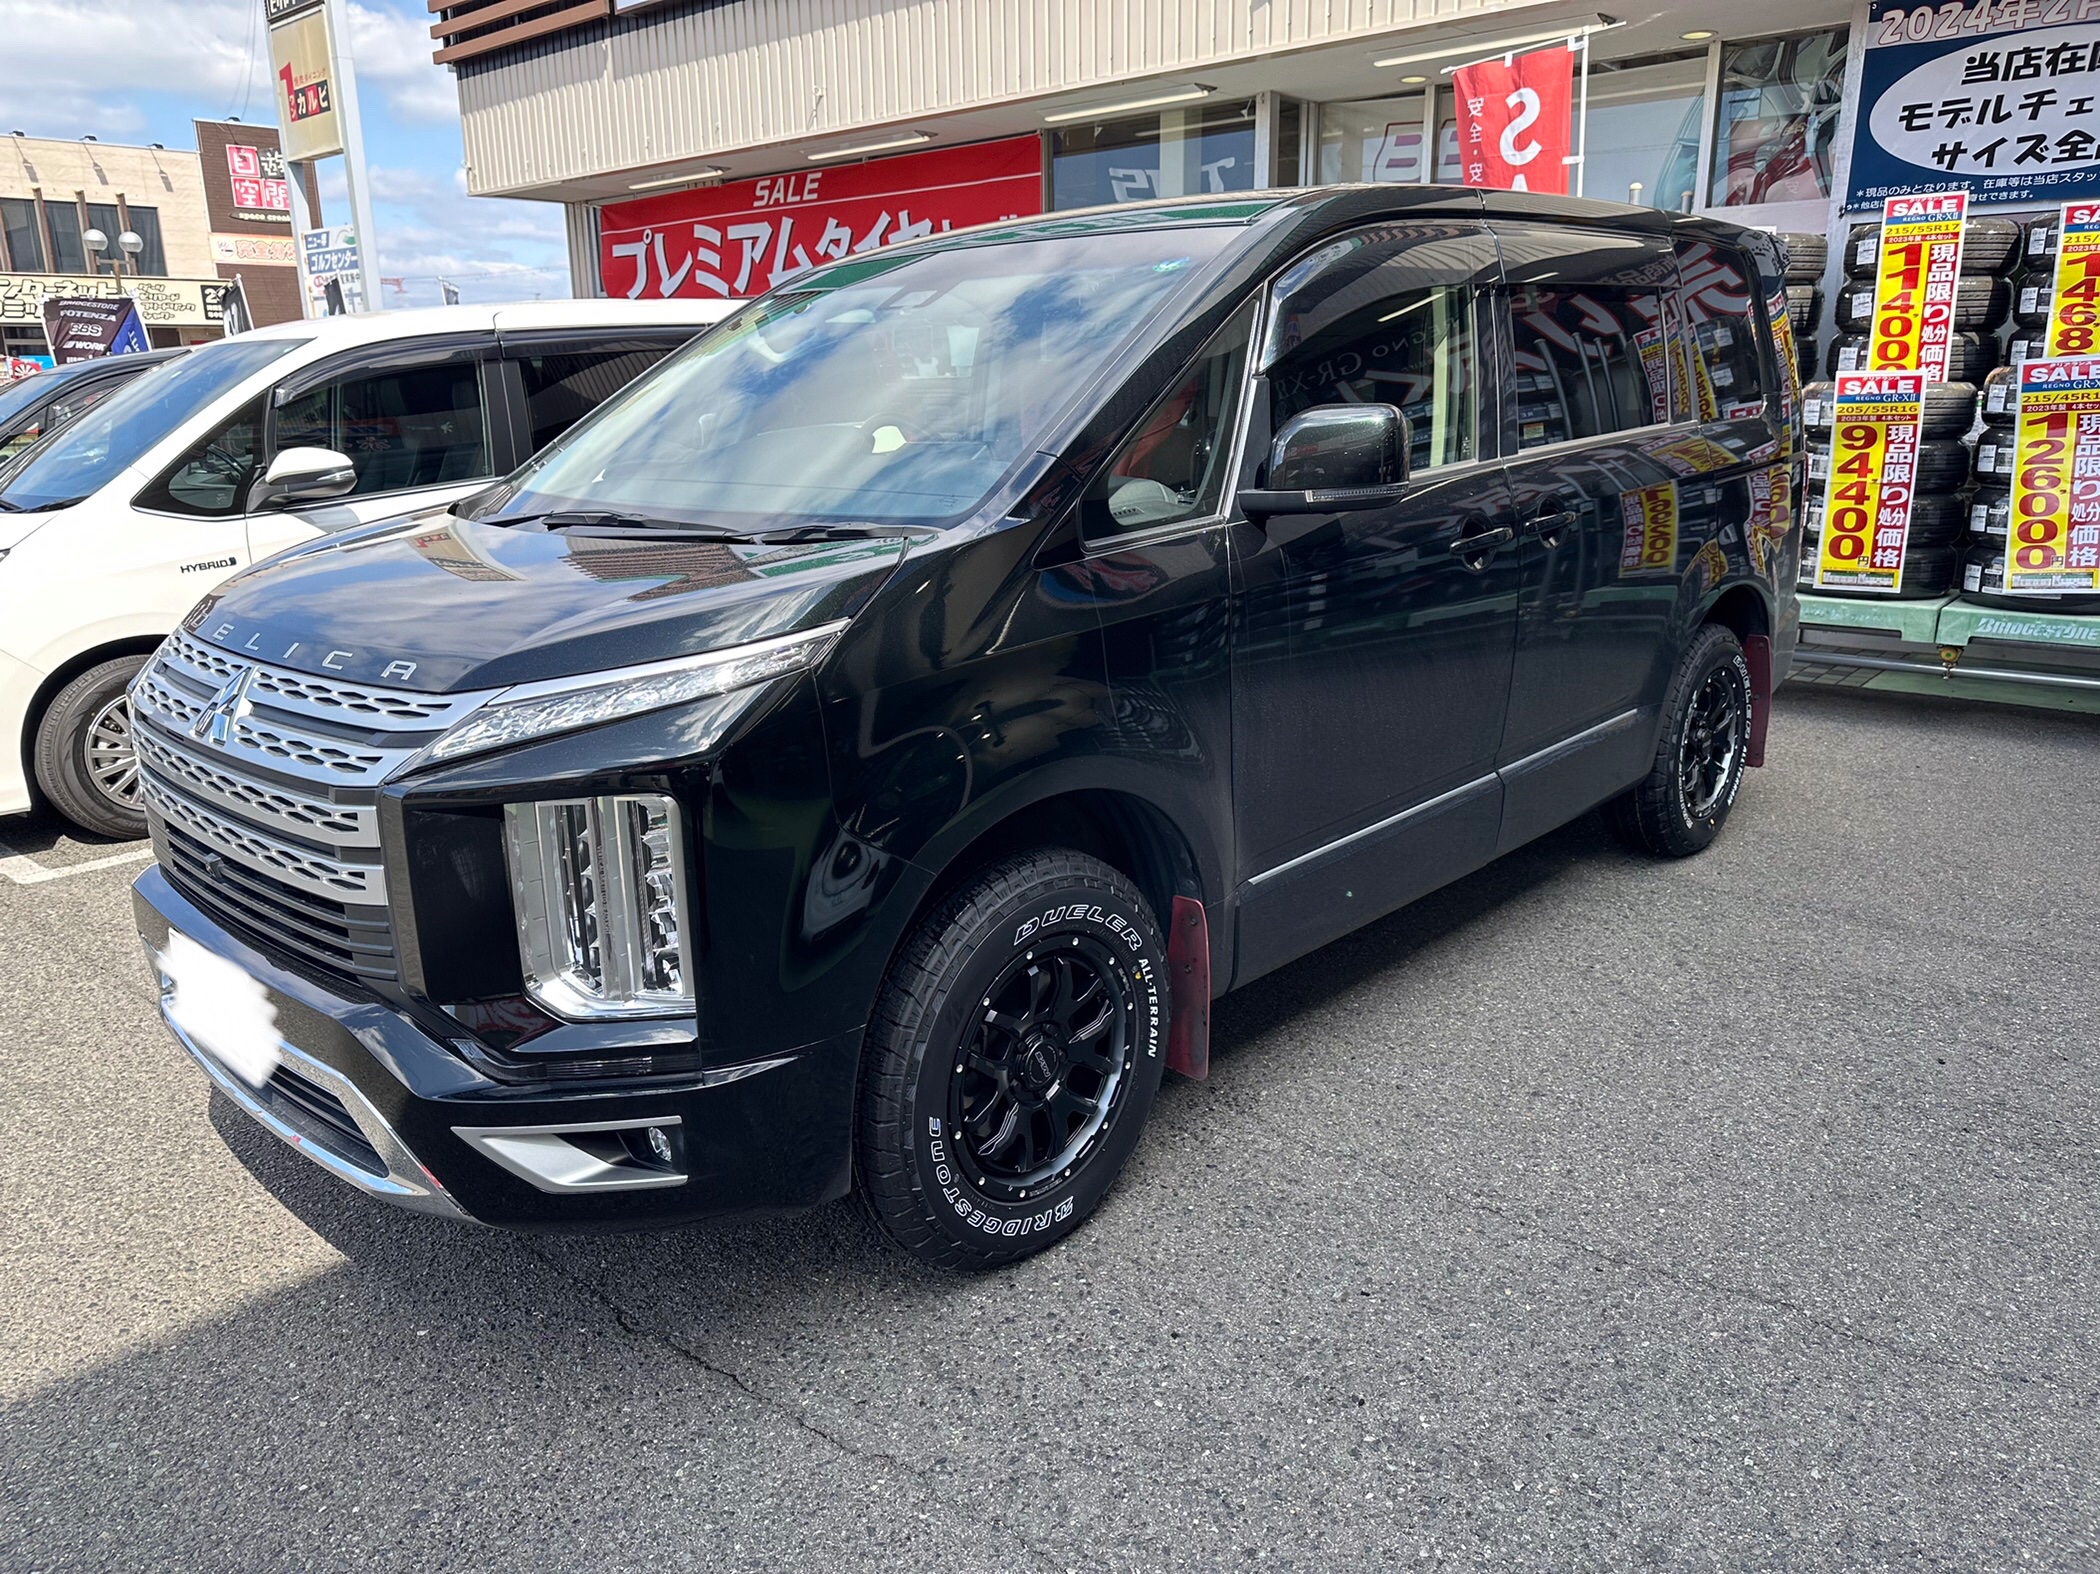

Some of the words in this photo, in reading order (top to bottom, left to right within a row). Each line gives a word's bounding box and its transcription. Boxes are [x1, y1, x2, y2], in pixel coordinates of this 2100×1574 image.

[297, 84, 329, 115] カルビ
[1899, 88, 2095, 132] モデルチェ
[1931, 129, 2100, 171] サイズ全
[752, 172, 822, 208] SALE
[1892, 199, 1958, 216] SALE
[1886, 223, 1960, 235] 215/55R17
[311, 250, 358, 272] ゴルフセンター
[58, 301, 120, 310] BRIDGESTONE
[60, 310, 117, 321] POTENZA
[1917, 243, 1957, 383] 現品限り処分価格
[69, 322, 103, 337] BBS
[74, 341, 107, 351] WORK
[2029, 364, 2100, 383] SALE
[1844, 379, 1915, 395] SALE
[1837, 406, 1918, 415] 205/55R16
[1873, 425, 1915, 568] 現品限り処分価格
[2064, 414, 2100, 567] 現品限り処分価格
[180, 559, 228, 574] HYBRID
[1857, 555, 1869, 566] 円
[2051, 555, 2064, 566] 円
[1975, 617, 2100, 641] BRIDGESTONE
[1013, 904, 1143, 951] DUELER
[1138, 958, 1160, 1058] ALL-TERRAIN
[928, 1116, 1074, 1237] BRIDGESTONE
